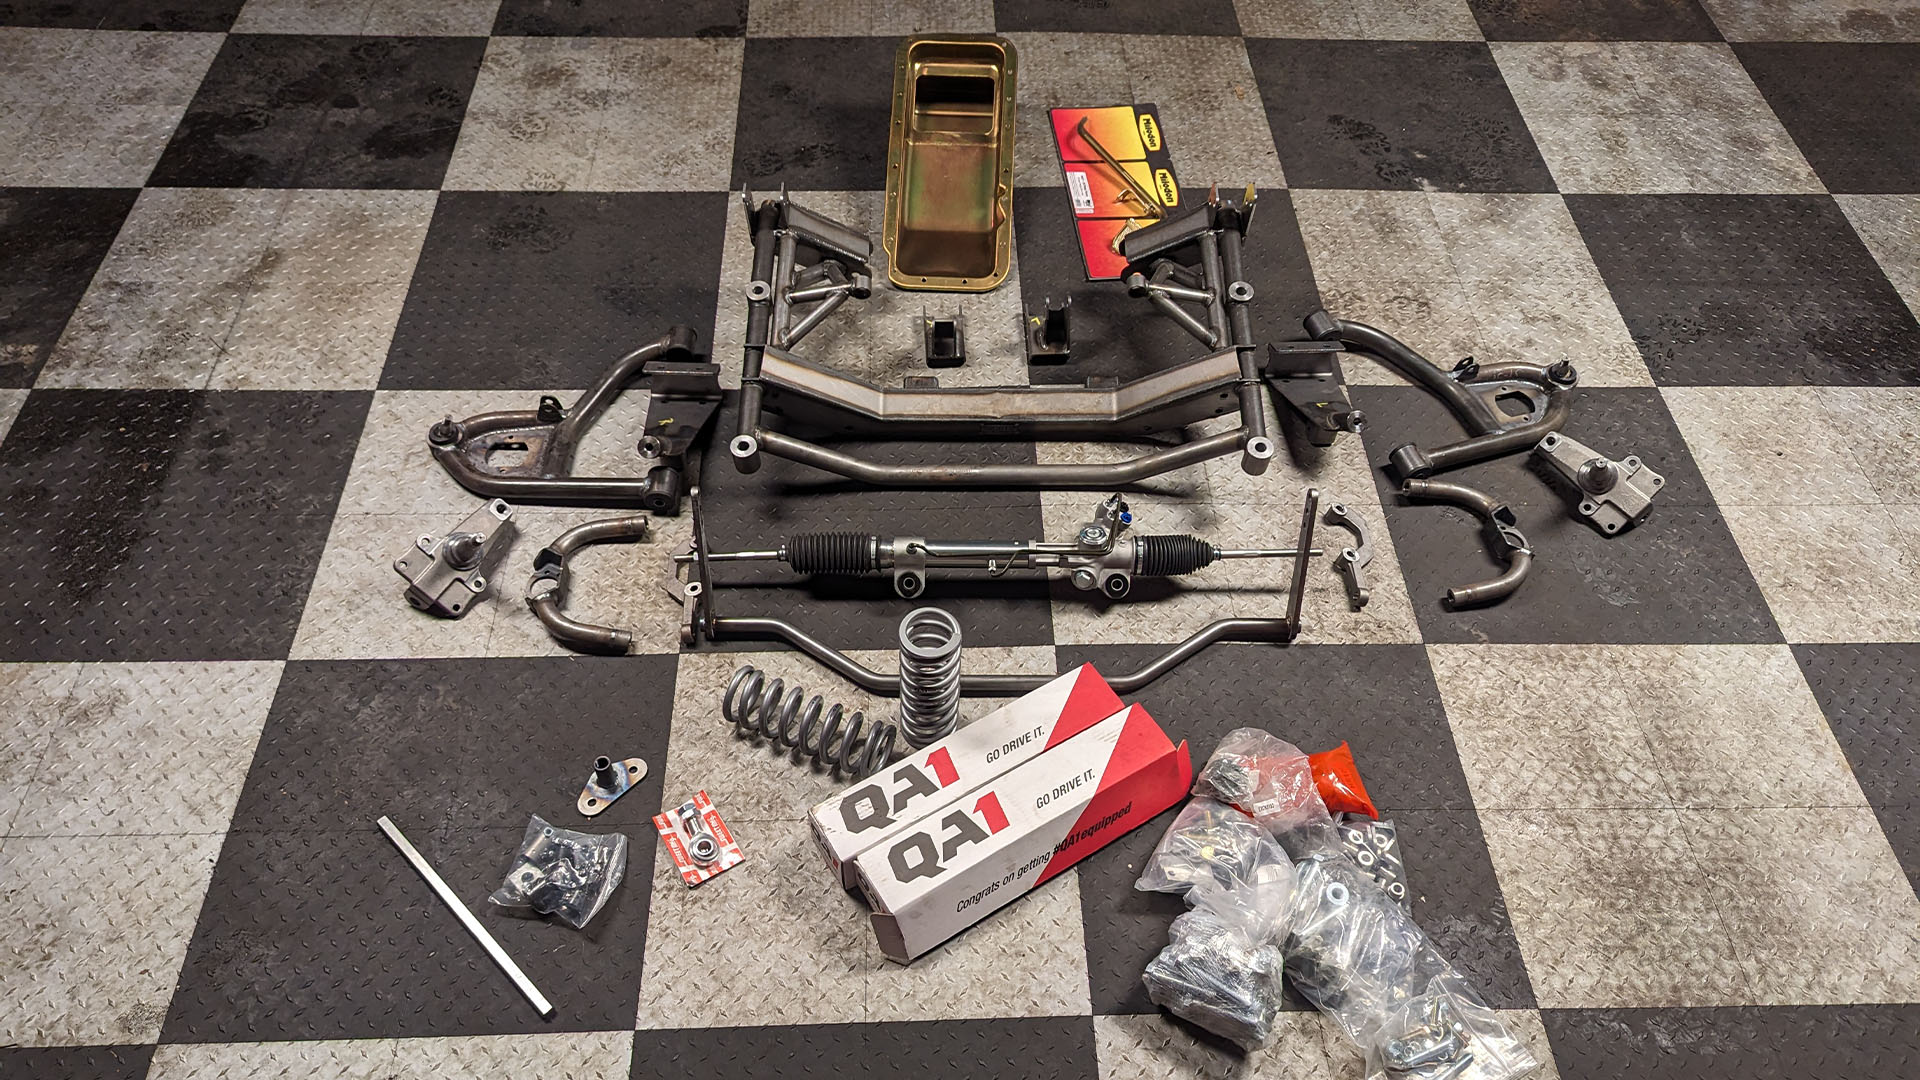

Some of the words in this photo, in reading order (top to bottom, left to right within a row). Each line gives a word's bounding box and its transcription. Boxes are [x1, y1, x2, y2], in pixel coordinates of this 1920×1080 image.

[1143, 118, 1156, 147] Milodon
[1159, 172, 1173, 203] Milodon
[986, 749, 1000, 763] GO
[1002, 732, 1032, 755] DRIVE
[1033, 725, 1045, 739] IT.
[839, 746, 960, 834] QA1
[1036, 794, 1050, 809] GO
[1052, 775, 1082, 801] DRIVE
[1083, 769, 1096, 783] IT.
[887, 791, 1010, 883] QA1
[956, 880, 1000, 912] Congrats
[1002, 873, 1015, 886] on
[1017, 851, 1050, 880] getting
[1053, 801, 1132, 855] #QA1equipped
